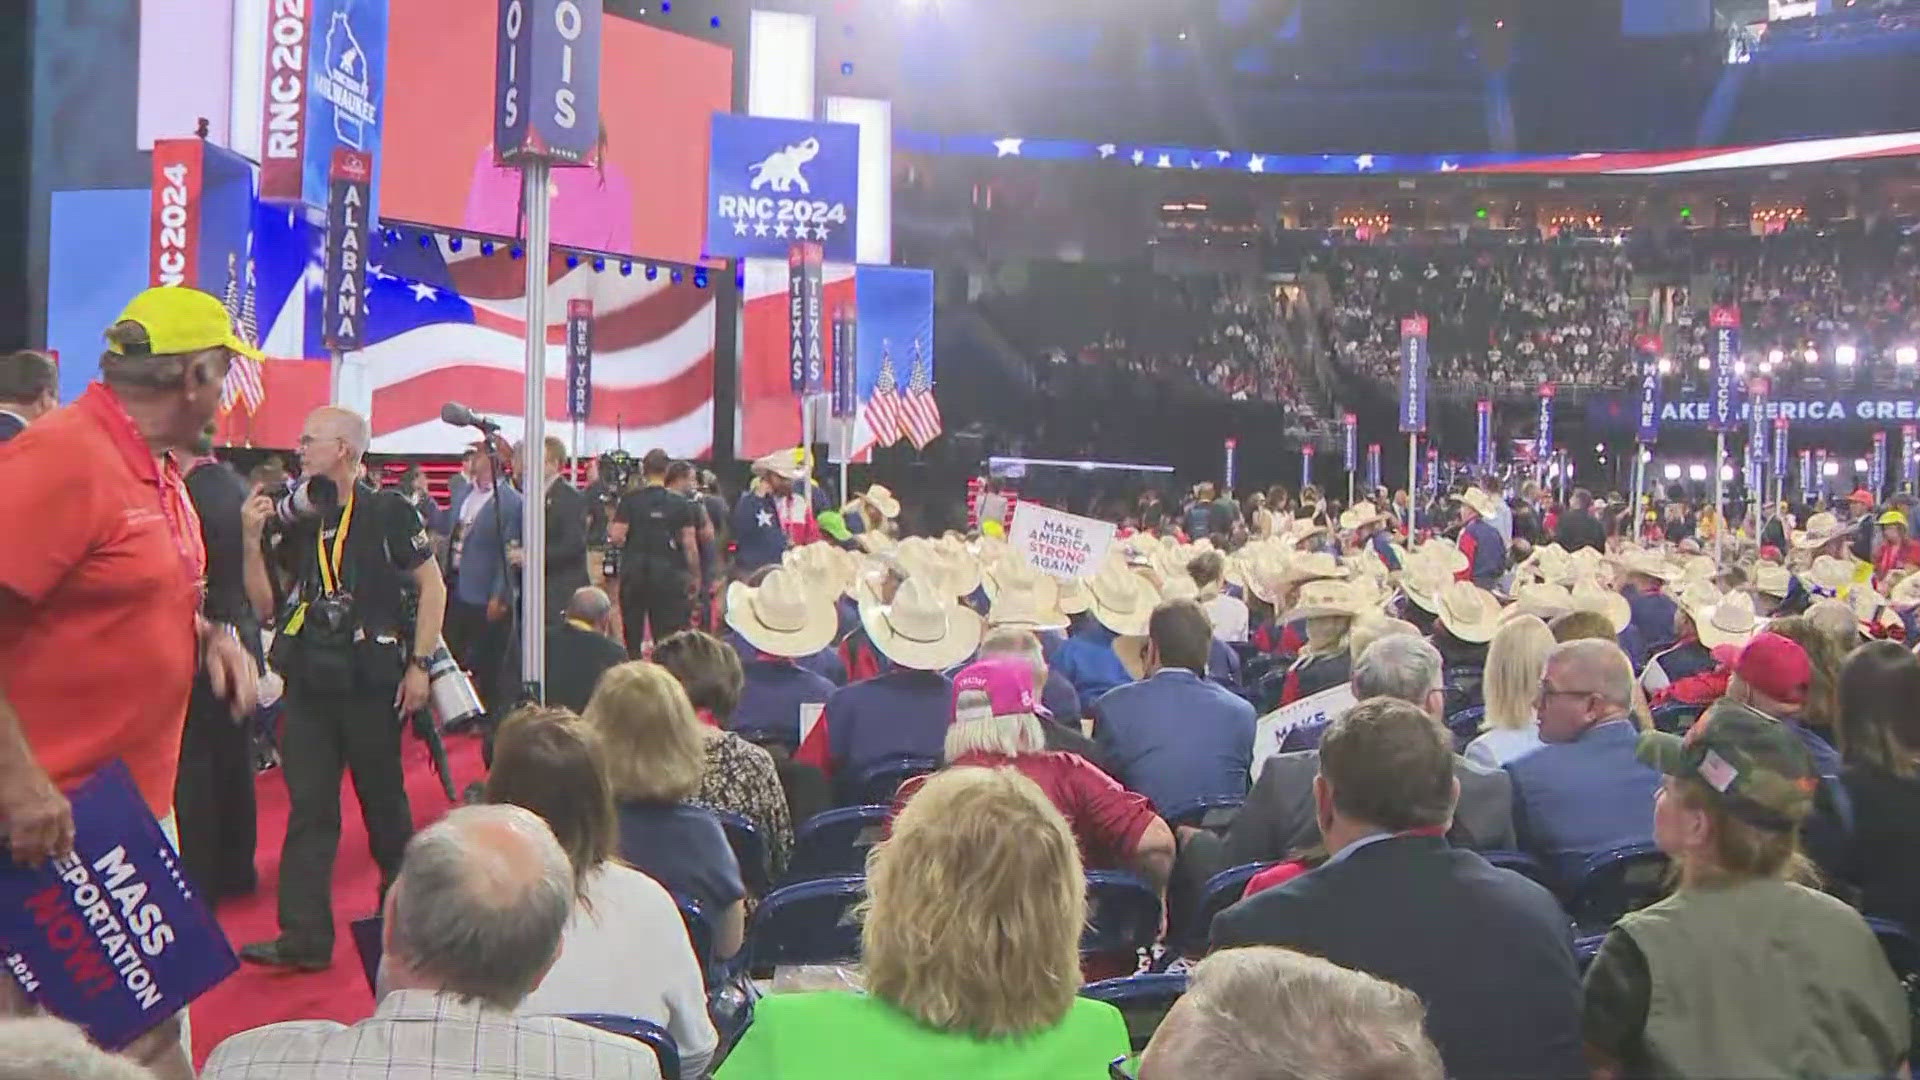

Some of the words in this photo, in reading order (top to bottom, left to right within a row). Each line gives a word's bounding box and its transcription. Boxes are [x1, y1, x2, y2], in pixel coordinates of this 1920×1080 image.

[338, 185, 361, 338] ALABAMA
[576, 320, 588, 357] NEW
[791, 276, 803, 380] TEXAS
[809, 276, 819, 381] TEXAS
[576, 363, 586, 414] YORK
[1641, 362, 1657, 427] MAINE
[1717, 328, 1730, 423] KENTUCKY
[1661, 402, 1711, 420] AKE
[1735, 401, 1846, 420] ERICA
[1029, 529, 1091, 553] AMERICA
[1030, 541, 1085, 564] STRONG
[1043, 520, 1085, 538] MAKE
[1031, 554, 1079, 576] AGAIN!
[93, 844, 175, 956] MASS
[53, 850, 163, 1011] EPORTATION
